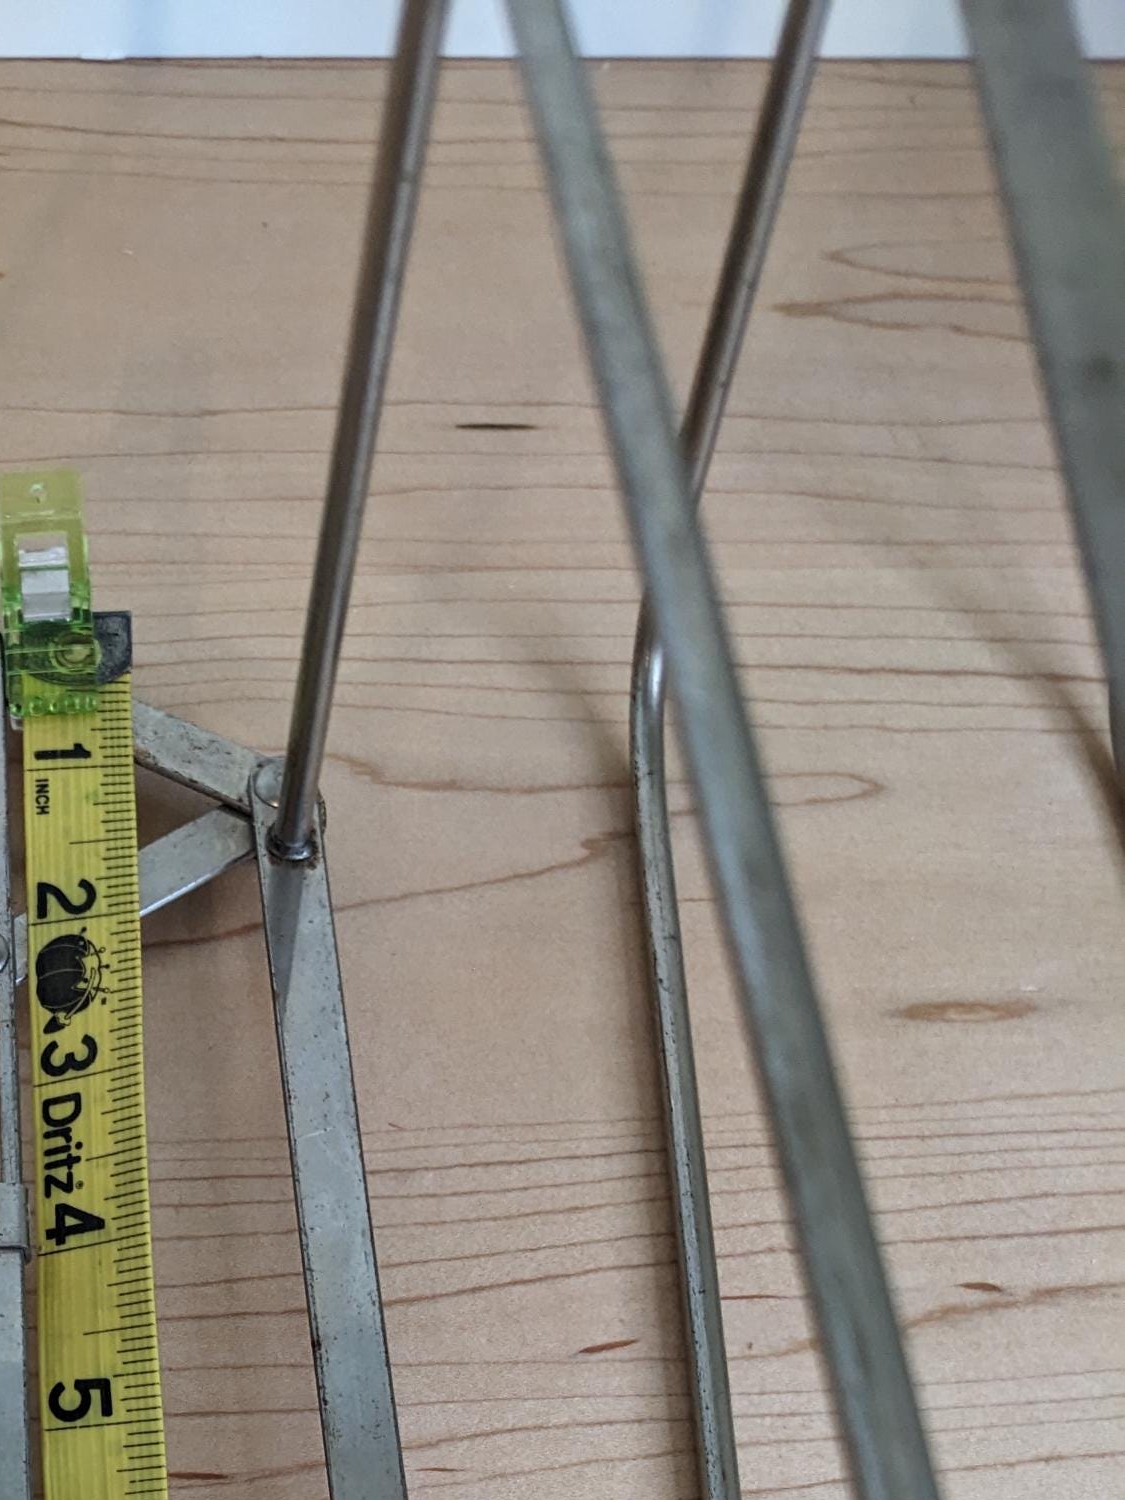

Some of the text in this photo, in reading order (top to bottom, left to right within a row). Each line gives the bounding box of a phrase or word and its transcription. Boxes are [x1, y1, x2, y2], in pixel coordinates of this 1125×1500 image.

[34, 743, 91, 760] 1
[35, 778, 50, 815] INCH
[36, 879, 97, 919] 2
[40, 1034, 98, 1077] 3
[45, 1202, 106, 1246] 4
[48, 1378, 114, 1423] 5
